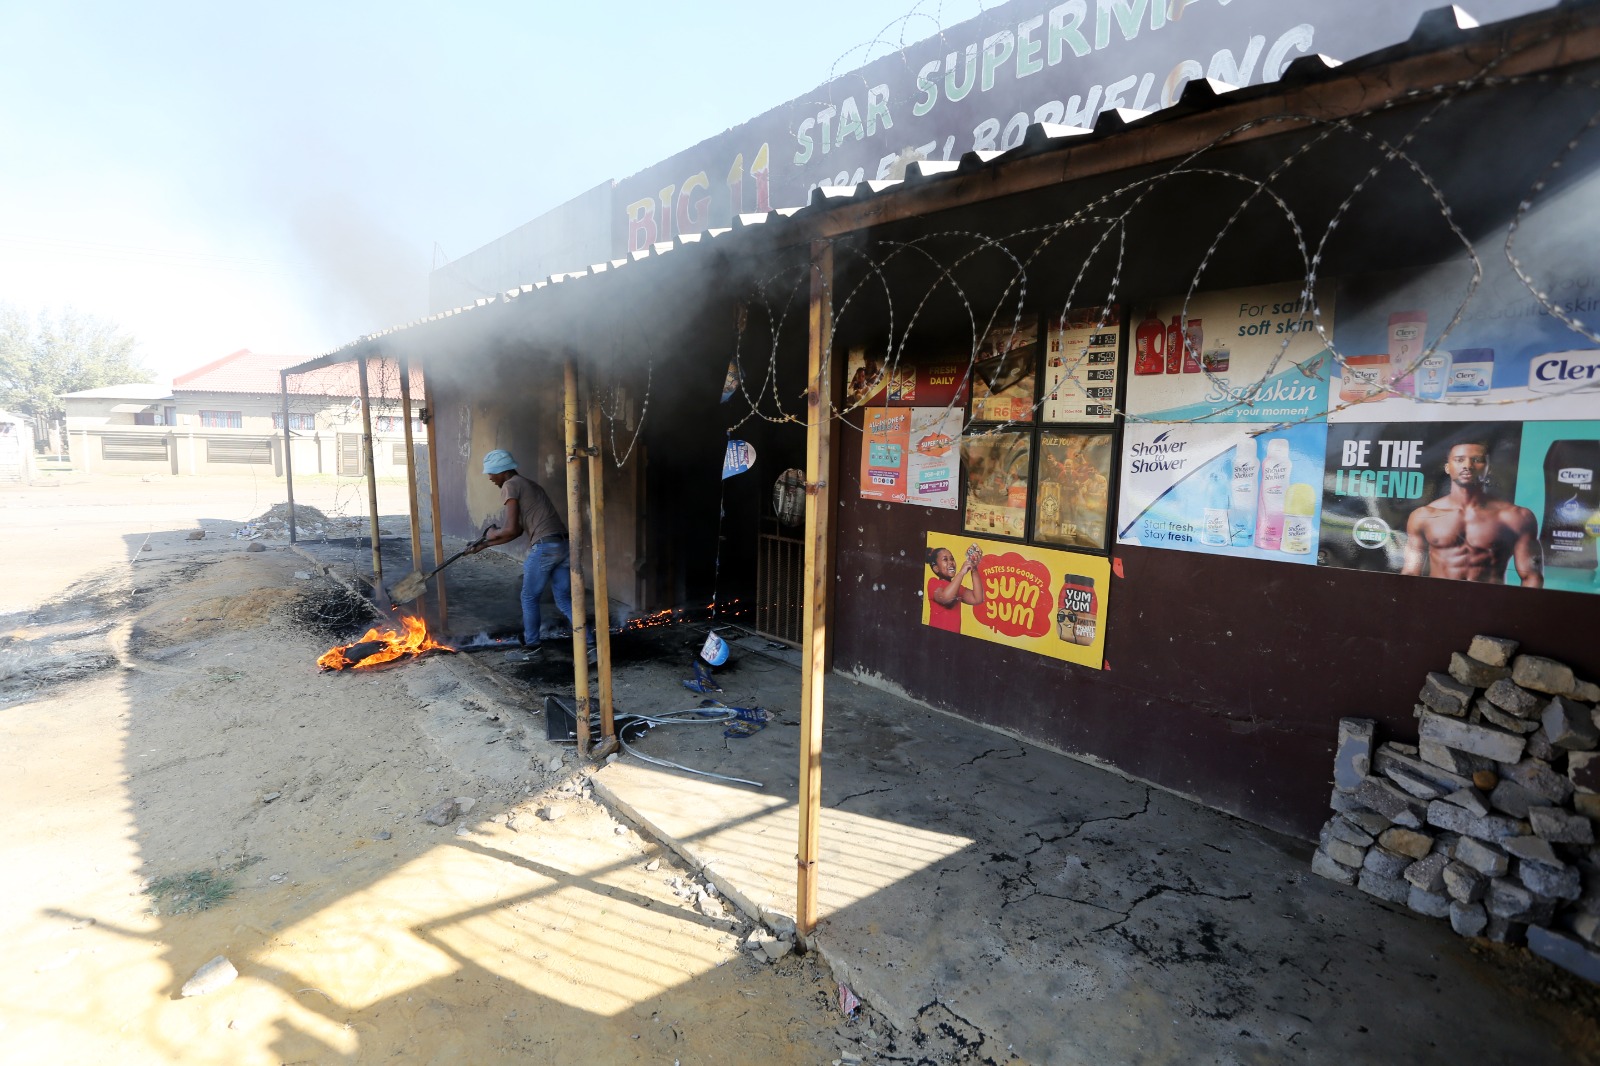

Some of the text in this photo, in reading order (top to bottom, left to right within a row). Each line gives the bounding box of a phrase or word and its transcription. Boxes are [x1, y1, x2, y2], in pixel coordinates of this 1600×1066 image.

[626, 171, 710, 252] BIG
[726, 143, 773, 213] 11
[793, 84, 894, 166] STAR
[1239, 303, 1268, 317] For
[1238, 320, 1271, 336] soft
[929, 366, 957, 374] FRESH
[930, 377, 955, 385] DAILY
[993, 408, 1009, 417] R6
[1236, 409, 1260, 417] your
[1262, 406, 1309, 415] moment
[1130, 441, 1188, 457] Shower
[1341, 440, 1424, 468] BE THE
[1130, 458, 1188, 474] Shower
[1560, 470, 1590, 480] Clere
[1335, 469, 1425, 499] LEGEND
[1061, 523, 1077, 535] R12
[1144, 519, 1166, 529] Start
[1144, 529, 1193, 542] Stay fresh
[1552, 530, 1584, 539] LEGEND
[983, 565, 1005, 577] TASTES
[1066, 589, 1092, 602] YUM
[1064, 598, 1090, 612] YUM
